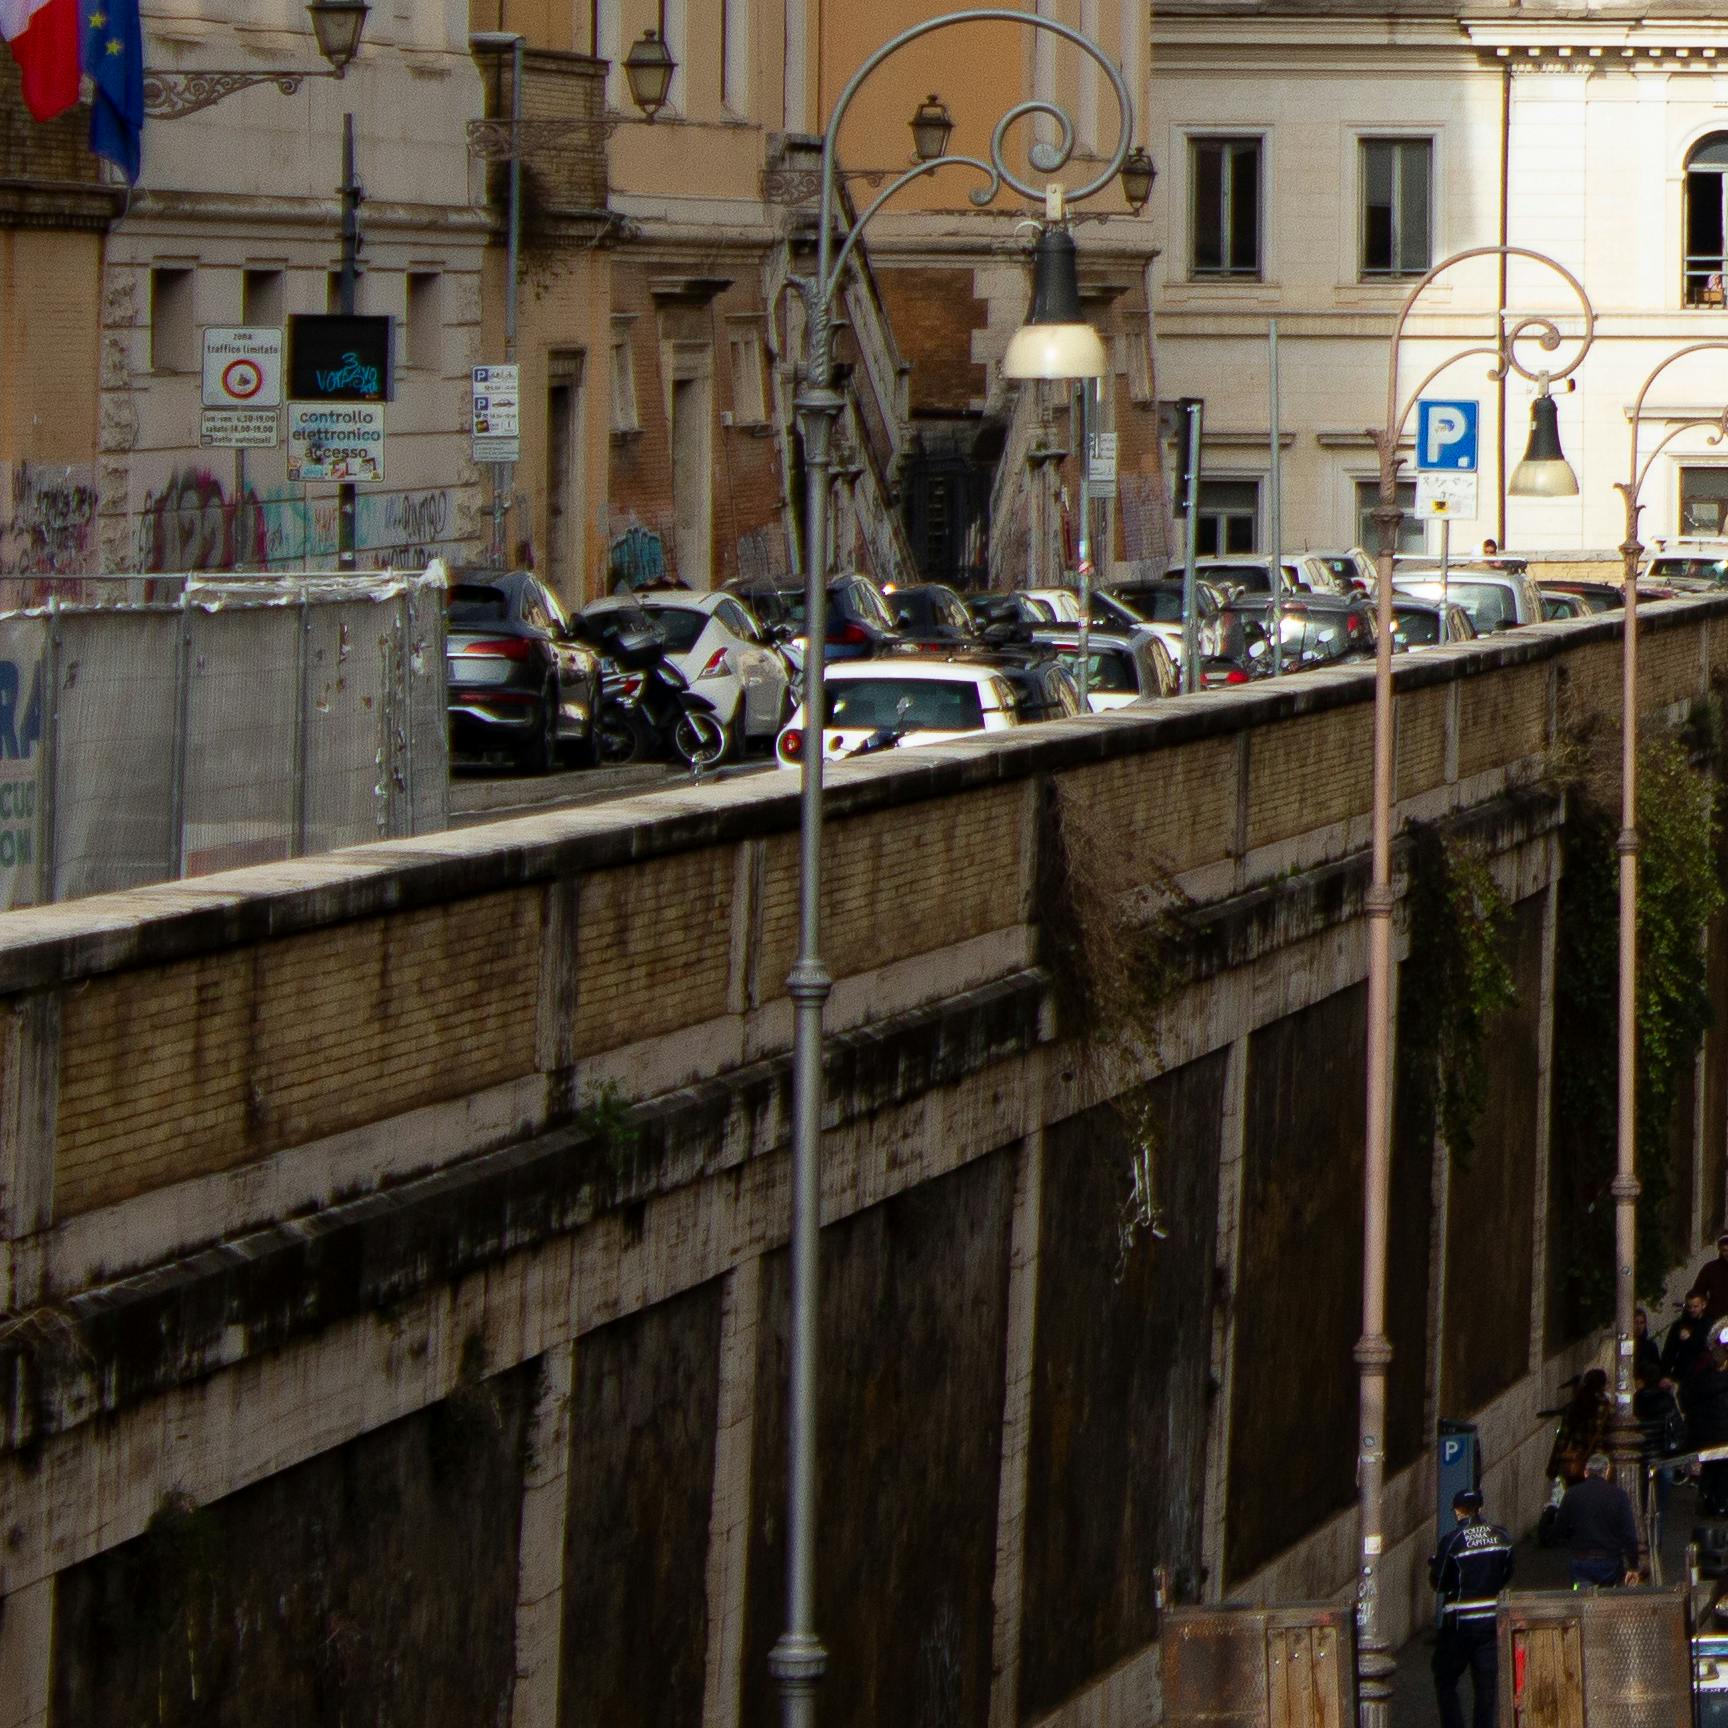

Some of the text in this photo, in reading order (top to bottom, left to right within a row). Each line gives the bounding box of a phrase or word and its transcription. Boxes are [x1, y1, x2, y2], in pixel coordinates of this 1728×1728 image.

[208, 344, 278, 354] traffico limitato
[478, 370, 486, 382] P
[478, 398, 486, 410] P
[300, 411, 373, 423] controllo
[293, 428, 380, 441] elettronico
[1427, 407, 1466, 463] P
[304, 447, 368, 459] accesso
[1445, 1441, 1458, 1461] P
[1462, 1526, 1492, 1536] POLIZIA
[1464, 1532, 1488, 1542] ROMA
[1466, 1537, 1498, 1548] CAPITALE
